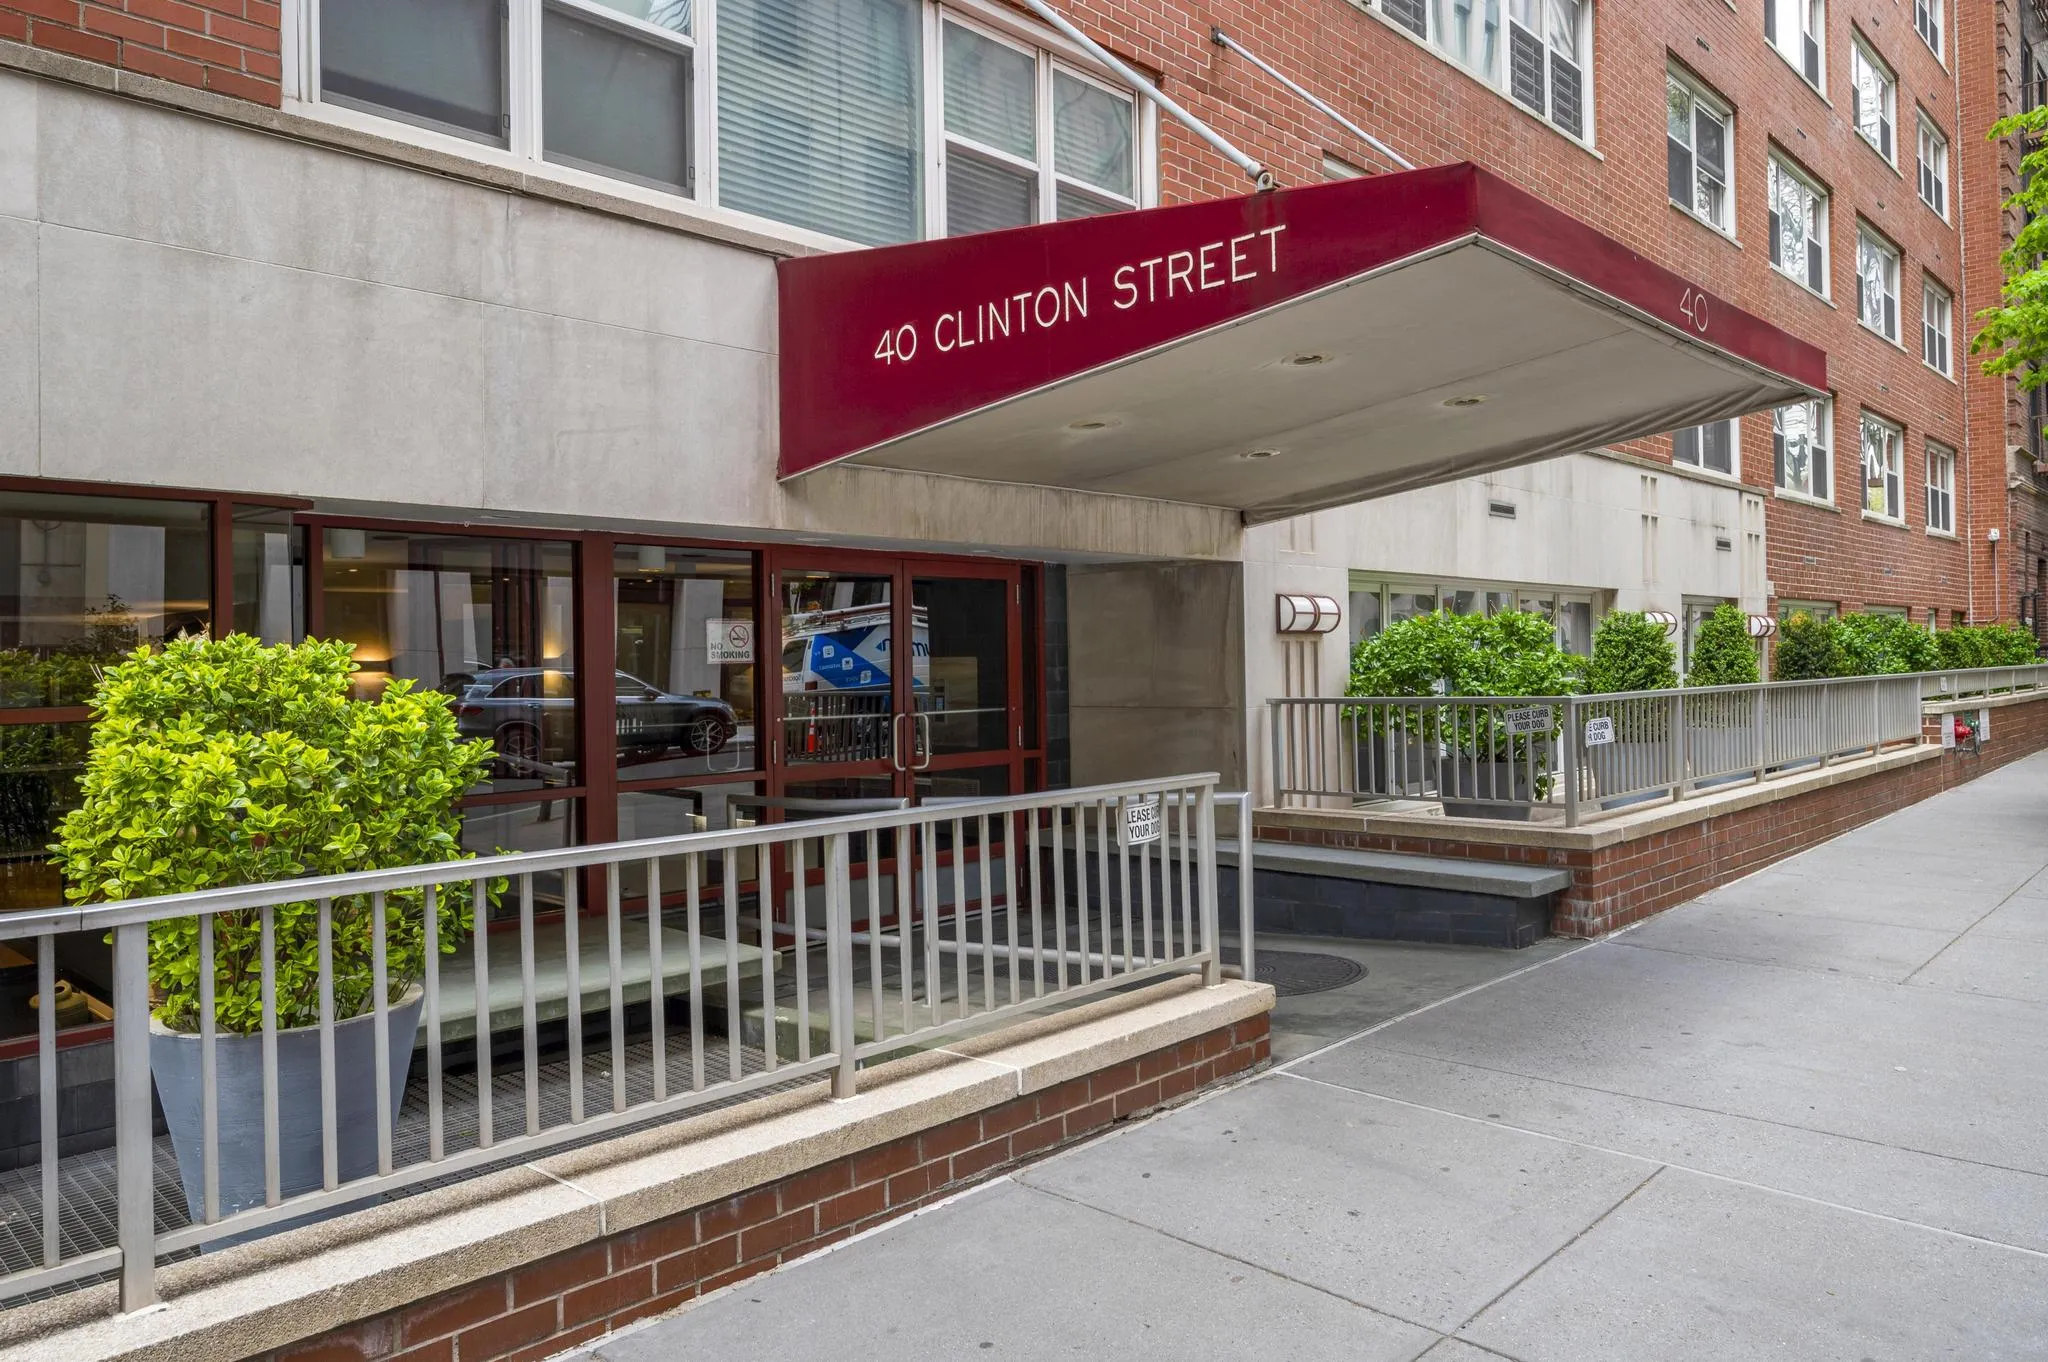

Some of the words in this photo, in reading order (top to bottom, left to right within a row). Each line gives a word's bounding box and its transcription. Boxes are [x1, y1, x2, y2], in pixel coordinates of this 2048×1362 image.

[874, 323, 918, 366] 40
[934, 276, 1089, 353] CLINTON
[1112, 223, 1287, 310] STREET
[1680, 287, 1709, 332] 40
[711, 641, 723, 651] NO
[711, 650, 750, 659] SMOKING
[1507, 710, 1531, 722] PLEASE
[1531, 708, 1549, 720] CURB
[1513, 721, 1530, 731] YOUR
[1531, 719, 1545, 729] DOG
[1593, 731, 1606, 741] DOG
[1126, 808, 1150, 823] LEASE
[1129, 823, 1150, 839] YOUR
